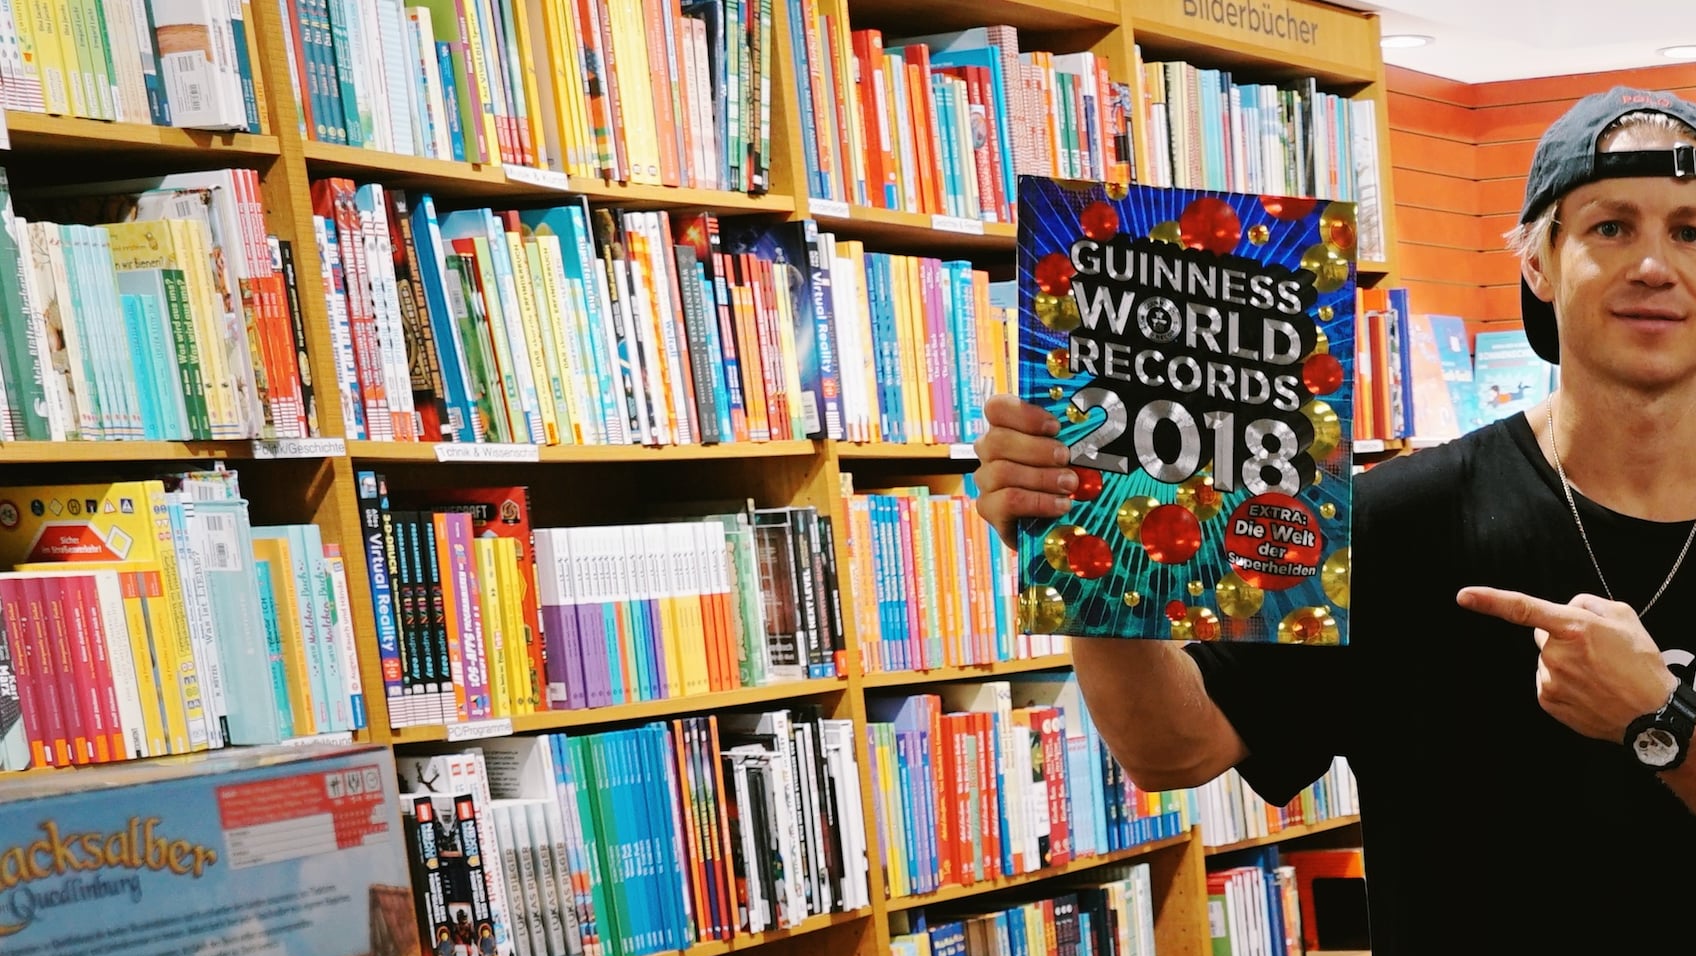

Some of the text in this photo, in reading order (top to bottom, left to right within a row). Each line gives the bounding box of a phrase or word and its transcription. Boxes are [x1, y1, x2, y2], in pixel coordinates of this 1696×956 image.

[1070, 239, 1302, 315] GUINNESS
[811, 271, 832, 373] Virtual Reality
[1071, 280, 1302, 366] WORLD
[1069, 335, 1300, 412] RECORDS
[1070, 386, 1300, 498] 2018
[1235, 520, 1315, 547] Die Welt
[1249, 504, 1307, 525] EXTRA:
[1258, 542, 1286, 558] der
[369, 533, 383, 589] Virtual
[377, 593, 394, 652] Reality
[1228, 551, 1316, 576] Superhelden
[506, 848, 526, 936] LUKAS RIEGER
[524, 846, 543, 934] LUKAS RIEGER
[540, 844, 561, 931] LUKAS RIEGER
[557, 842, 576, 929] LUKAS RIEGER
